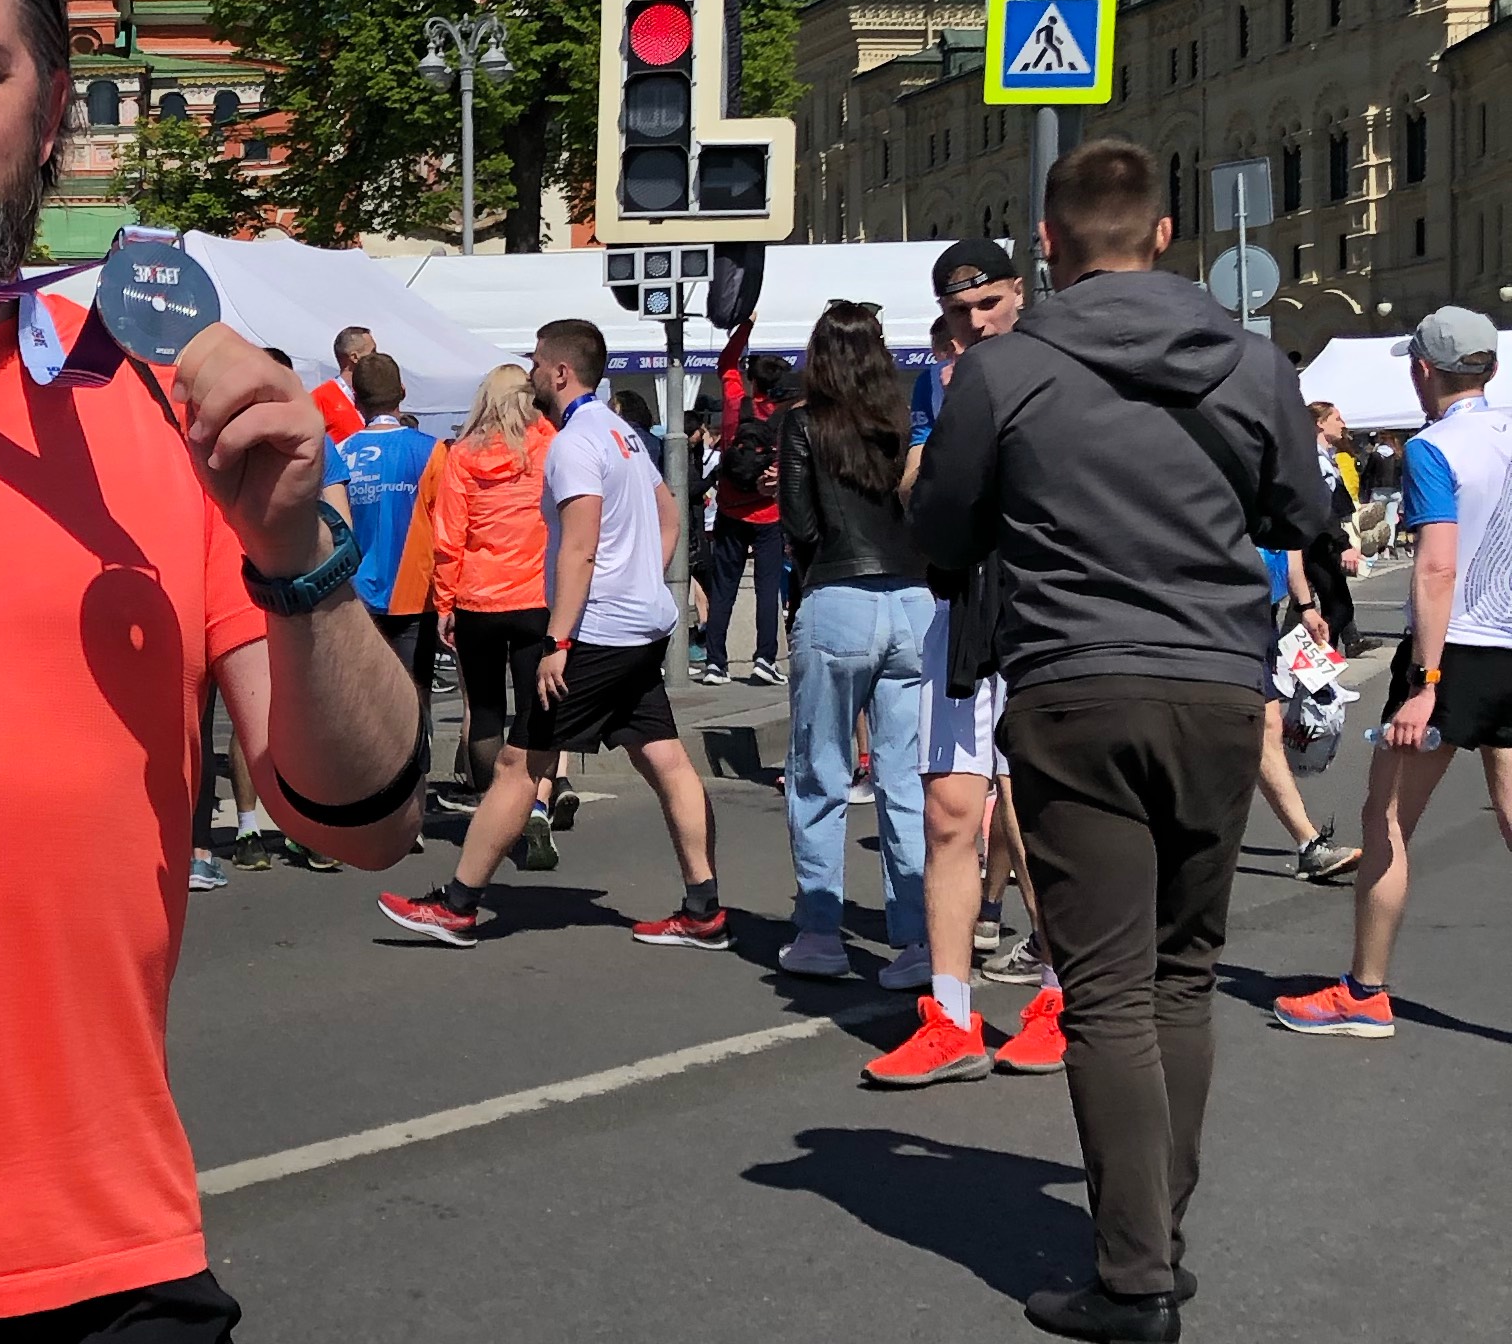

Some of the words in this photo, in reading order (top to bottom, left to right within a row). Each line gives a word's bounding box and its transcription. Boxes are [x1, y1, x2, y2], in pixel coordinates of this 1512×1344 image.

[684, 355, 719, 370] Каме
[906, 353, 924, 365] 34
[1295, 630, 1336, 675] 24547
